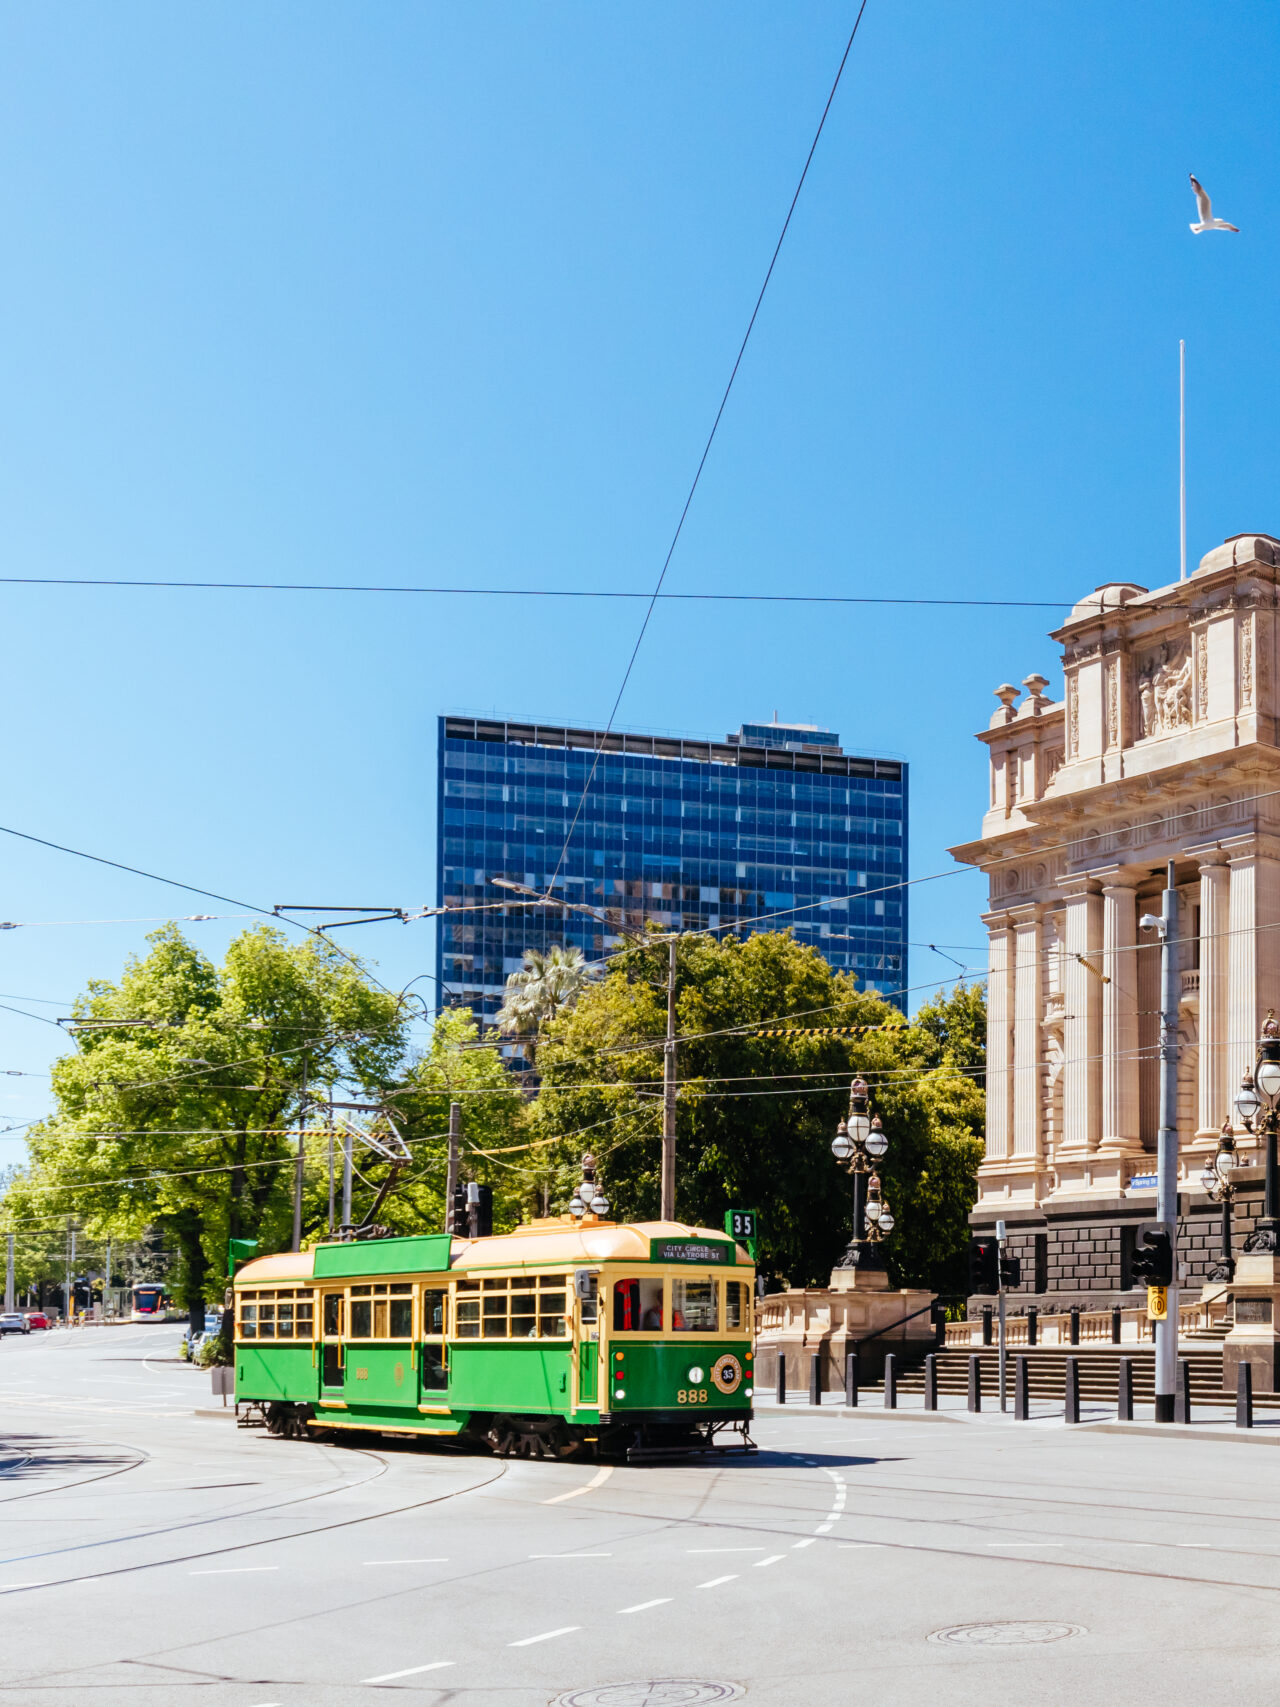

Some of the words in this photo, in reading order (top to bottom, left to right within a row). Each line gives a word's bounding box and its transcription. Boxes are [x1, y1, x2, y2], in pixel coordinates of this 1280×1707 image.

[734, 1215, 751, 1235] 35
[1154, 1301, 1162, 1311] 10
[724, 1369, 734, 1379] 35
[677, 1389, 708, 1403] 888
